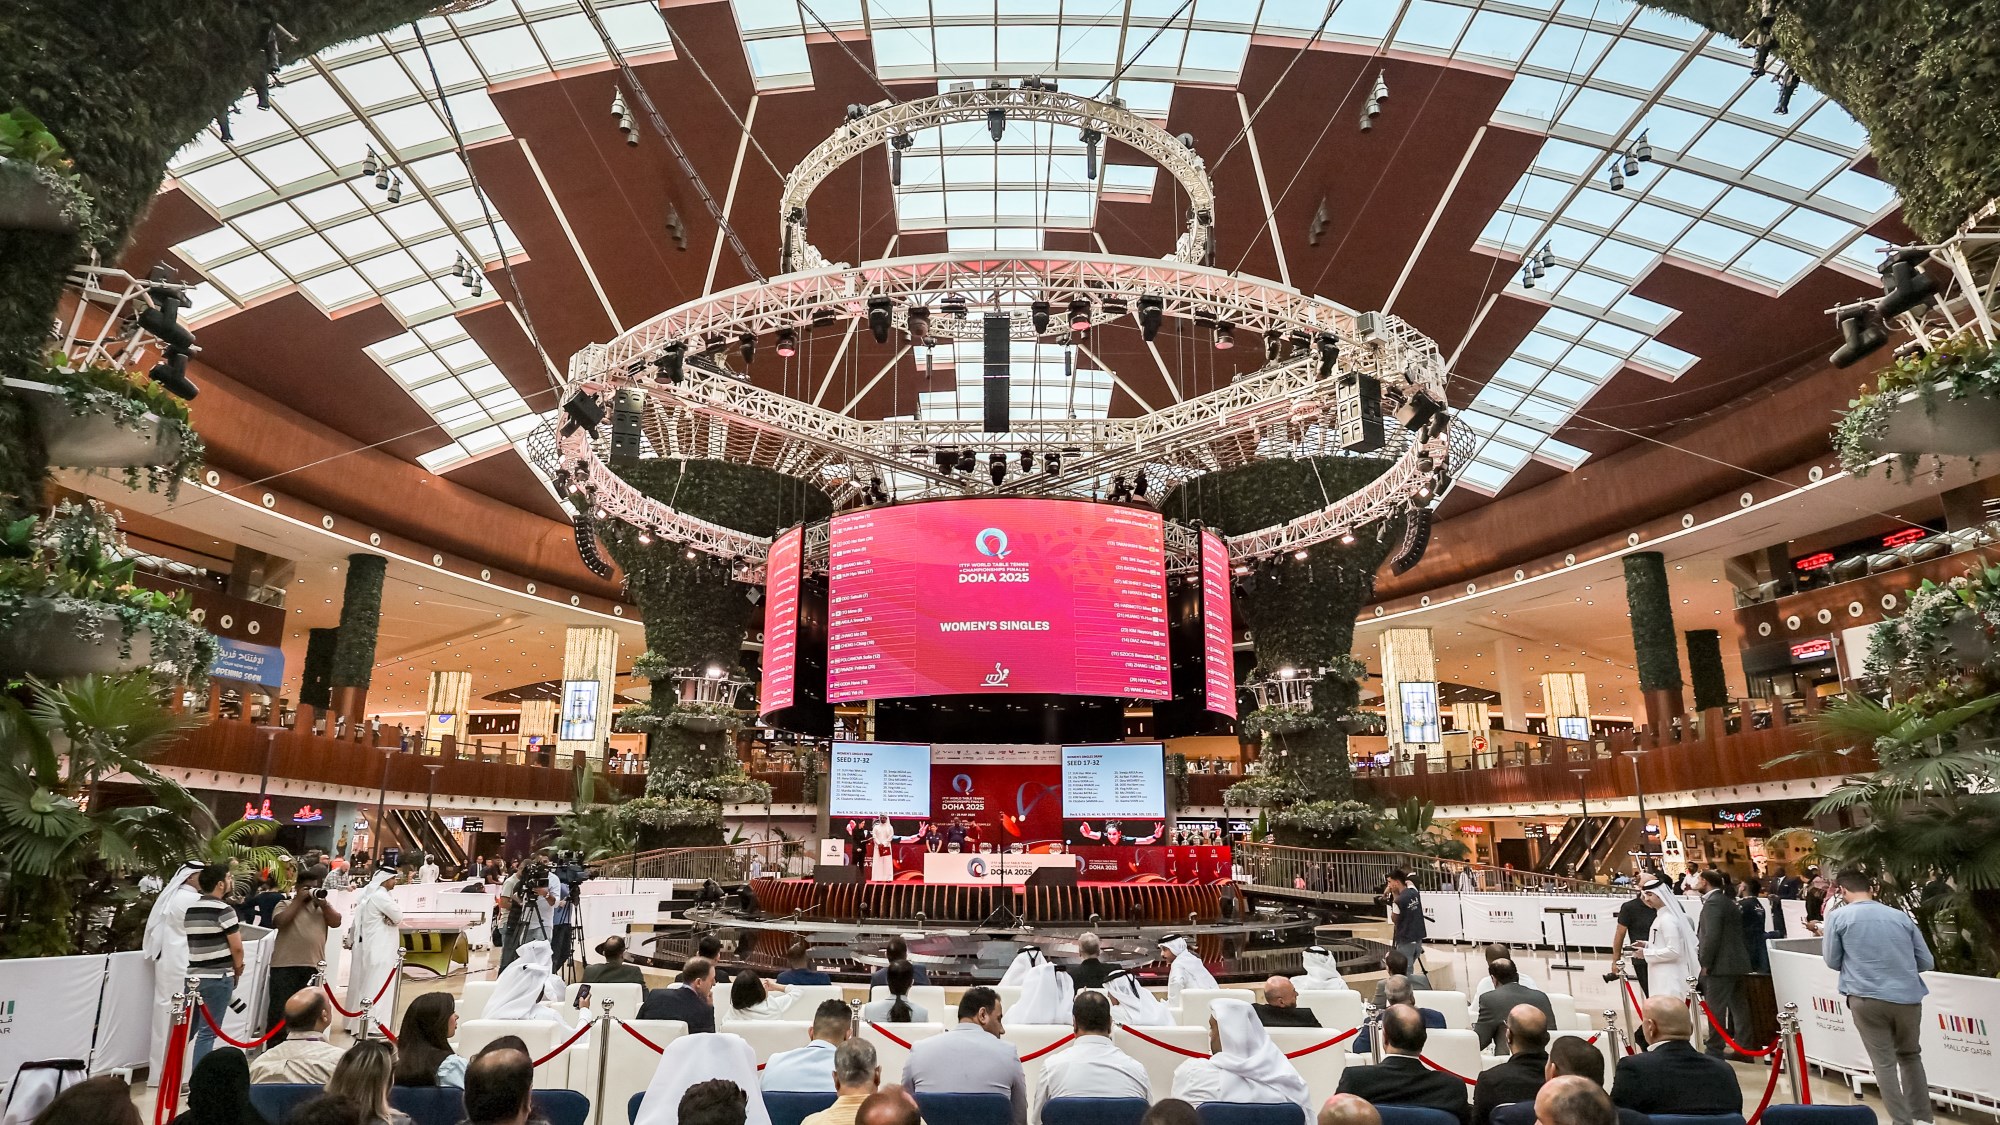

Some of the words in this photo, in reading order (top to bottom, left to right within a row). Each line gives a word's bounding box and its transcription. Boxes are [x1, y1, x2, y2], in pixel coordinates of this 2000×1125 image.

[959, 573, 996, 583] DOHA
[999, 573, 1029, 582] 2025
[940, 621, 997, 632] WOMEN'S
[1000, 621, 1050, 631] SINGLES
[215, 667, 242, 678] OPENING
[244, 673, 262, 682] SOON
[1944, 1043, 1960, 1052] MALL
[1970, 1048, 1992, 1057] QATAR
